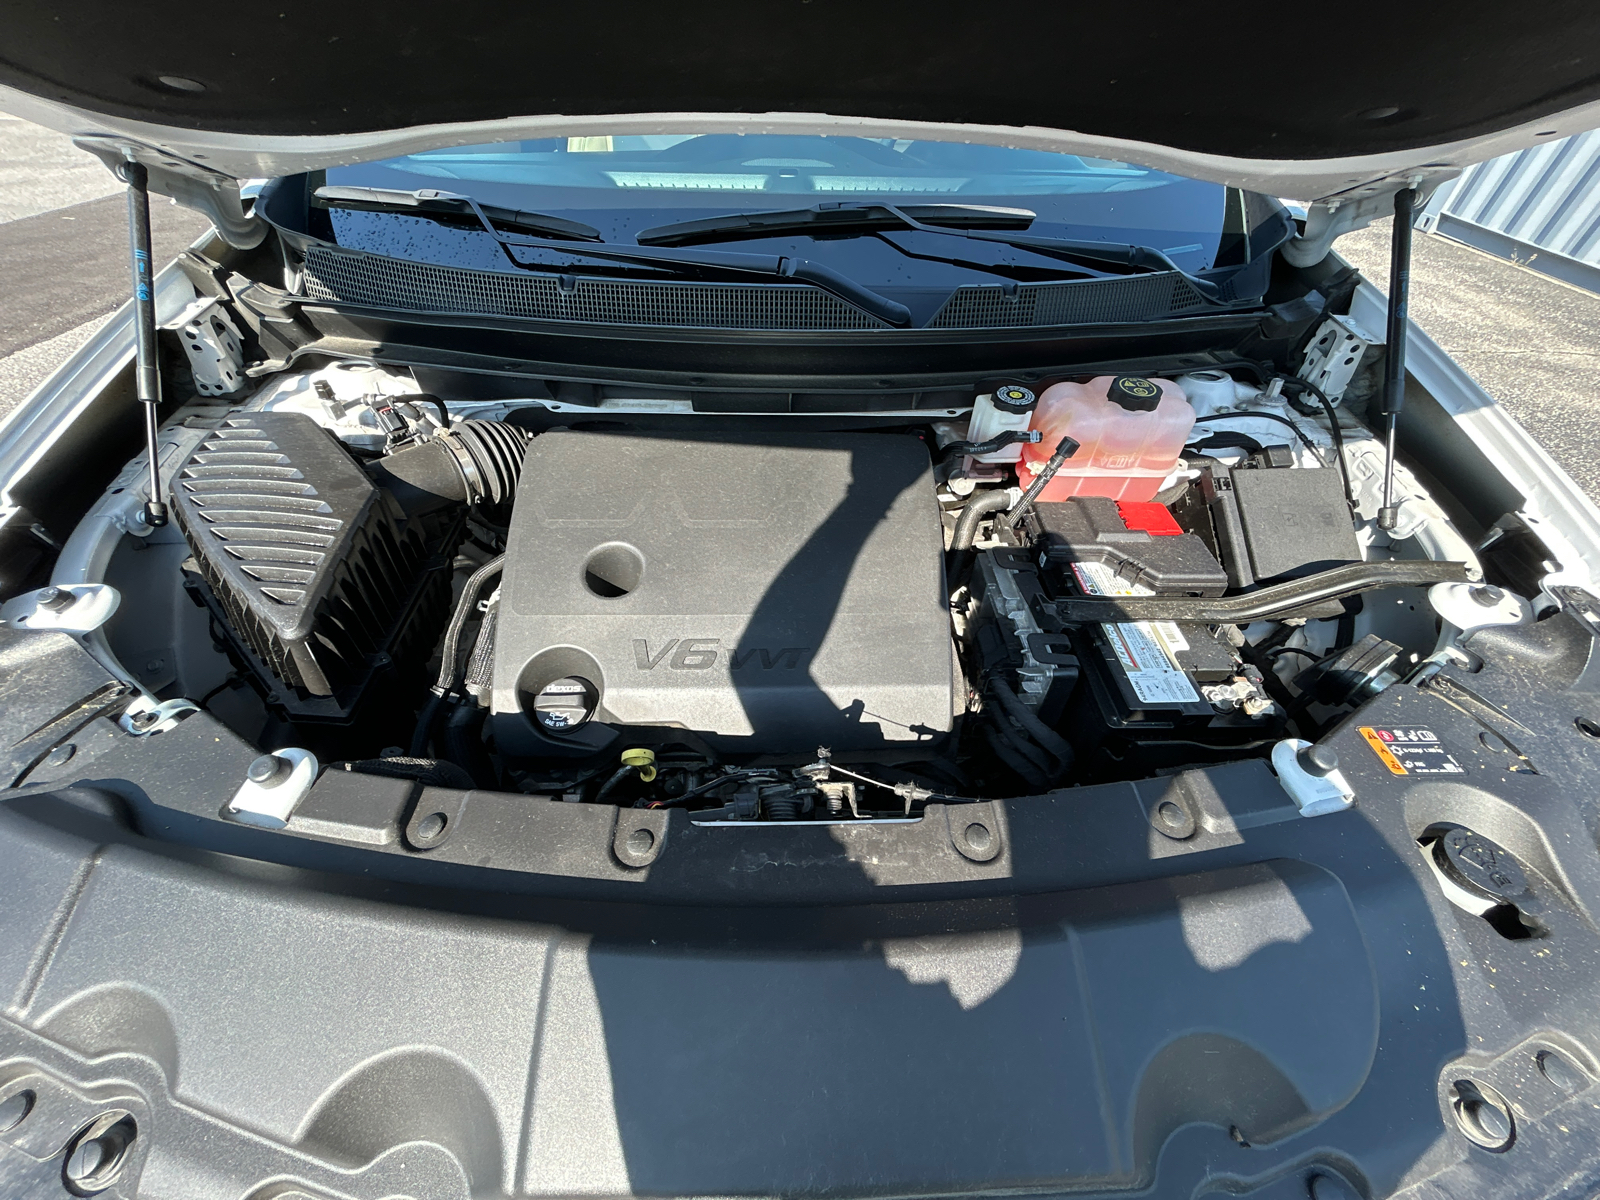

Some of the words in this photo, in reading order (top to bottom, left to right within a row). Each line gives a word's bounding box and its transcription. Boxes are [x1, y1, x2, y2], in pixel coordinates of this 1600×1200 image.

[632, 639, 720, 670] V6
[726, 648, 811, 670] VVT
[1105, 624, 1134, 667] ACDelco
[546, 684, 582, 692] dexos
[545, 718, 555, 727] SAE
